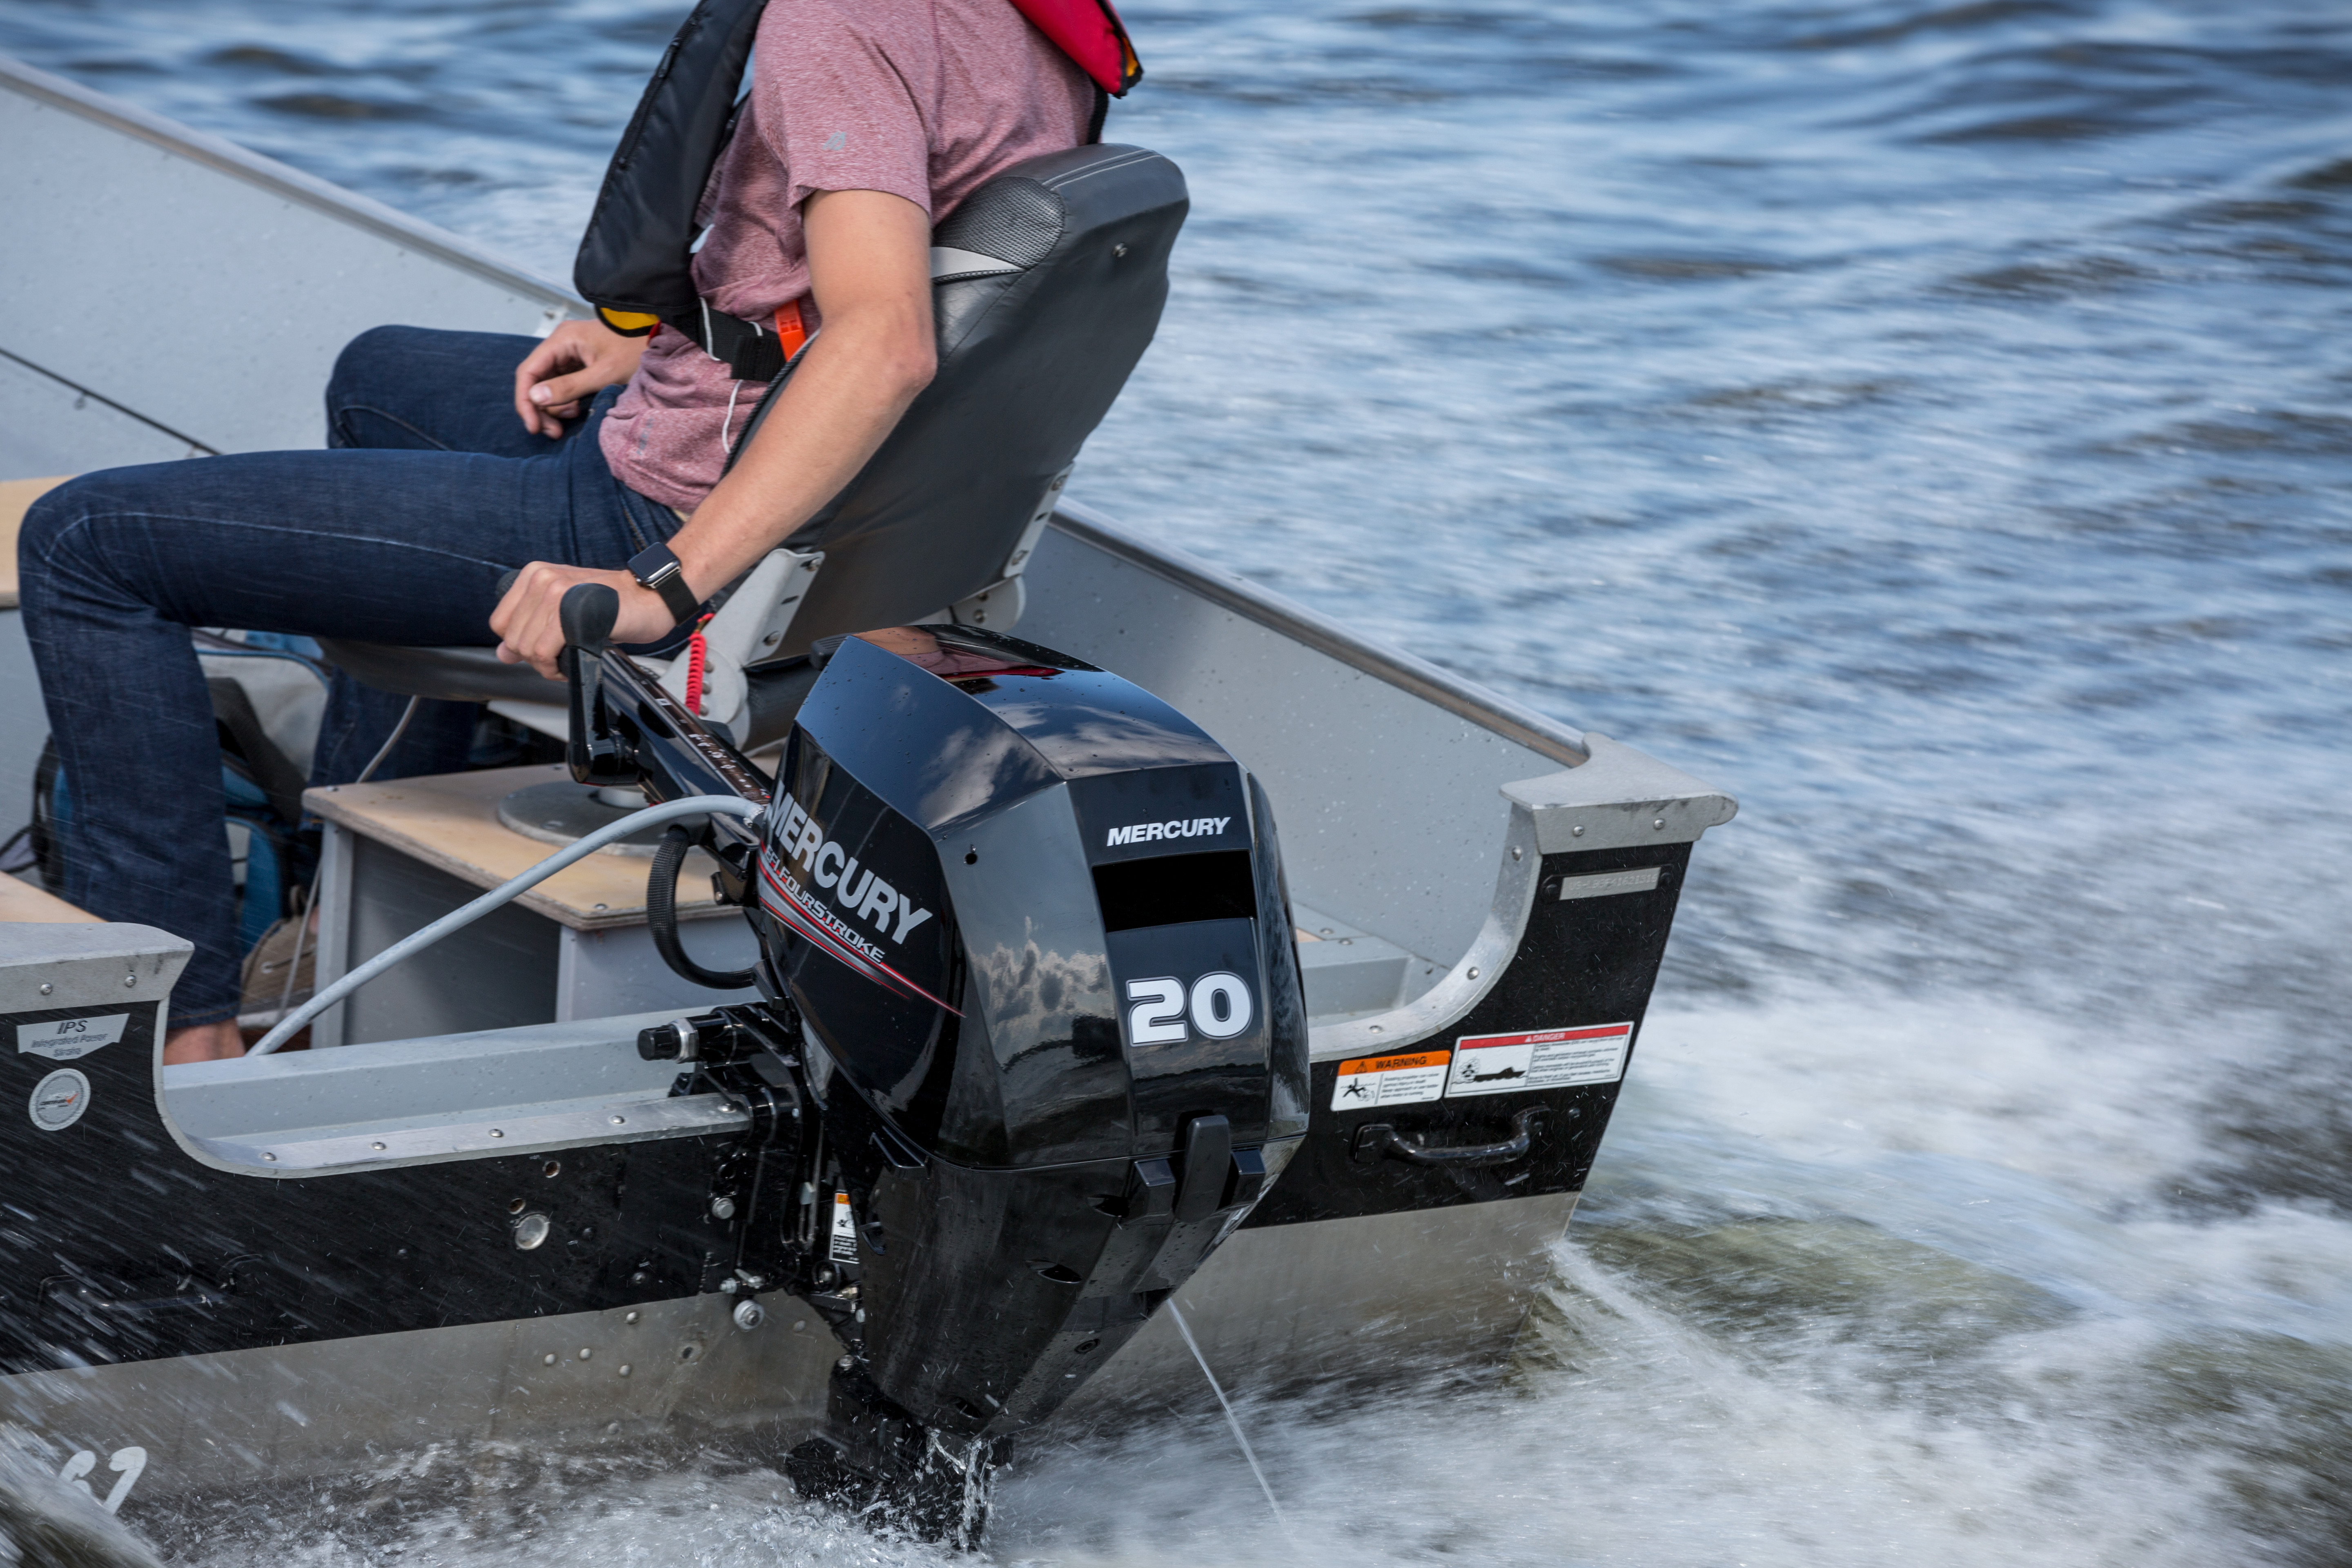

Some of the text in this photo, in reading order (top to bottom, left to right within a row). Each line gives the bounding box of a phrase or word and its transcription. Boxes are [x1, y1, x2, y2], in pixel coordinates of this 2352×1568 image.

[1106, 817, 1231, 846] MERCURY
[768, 778, 933, 944] MERCURY
[765, 844, 886, 964] EFI FOURSTROKE
[1125, 970, 1254, 1047] 20
[56, 1020, 88, 1035] IPS
[1532, 1033, 1566, 1041] DANGER
[31, 1033, 108, 1048] Integrated Power
[1375, 1056, 1427, 1069] WARNING
